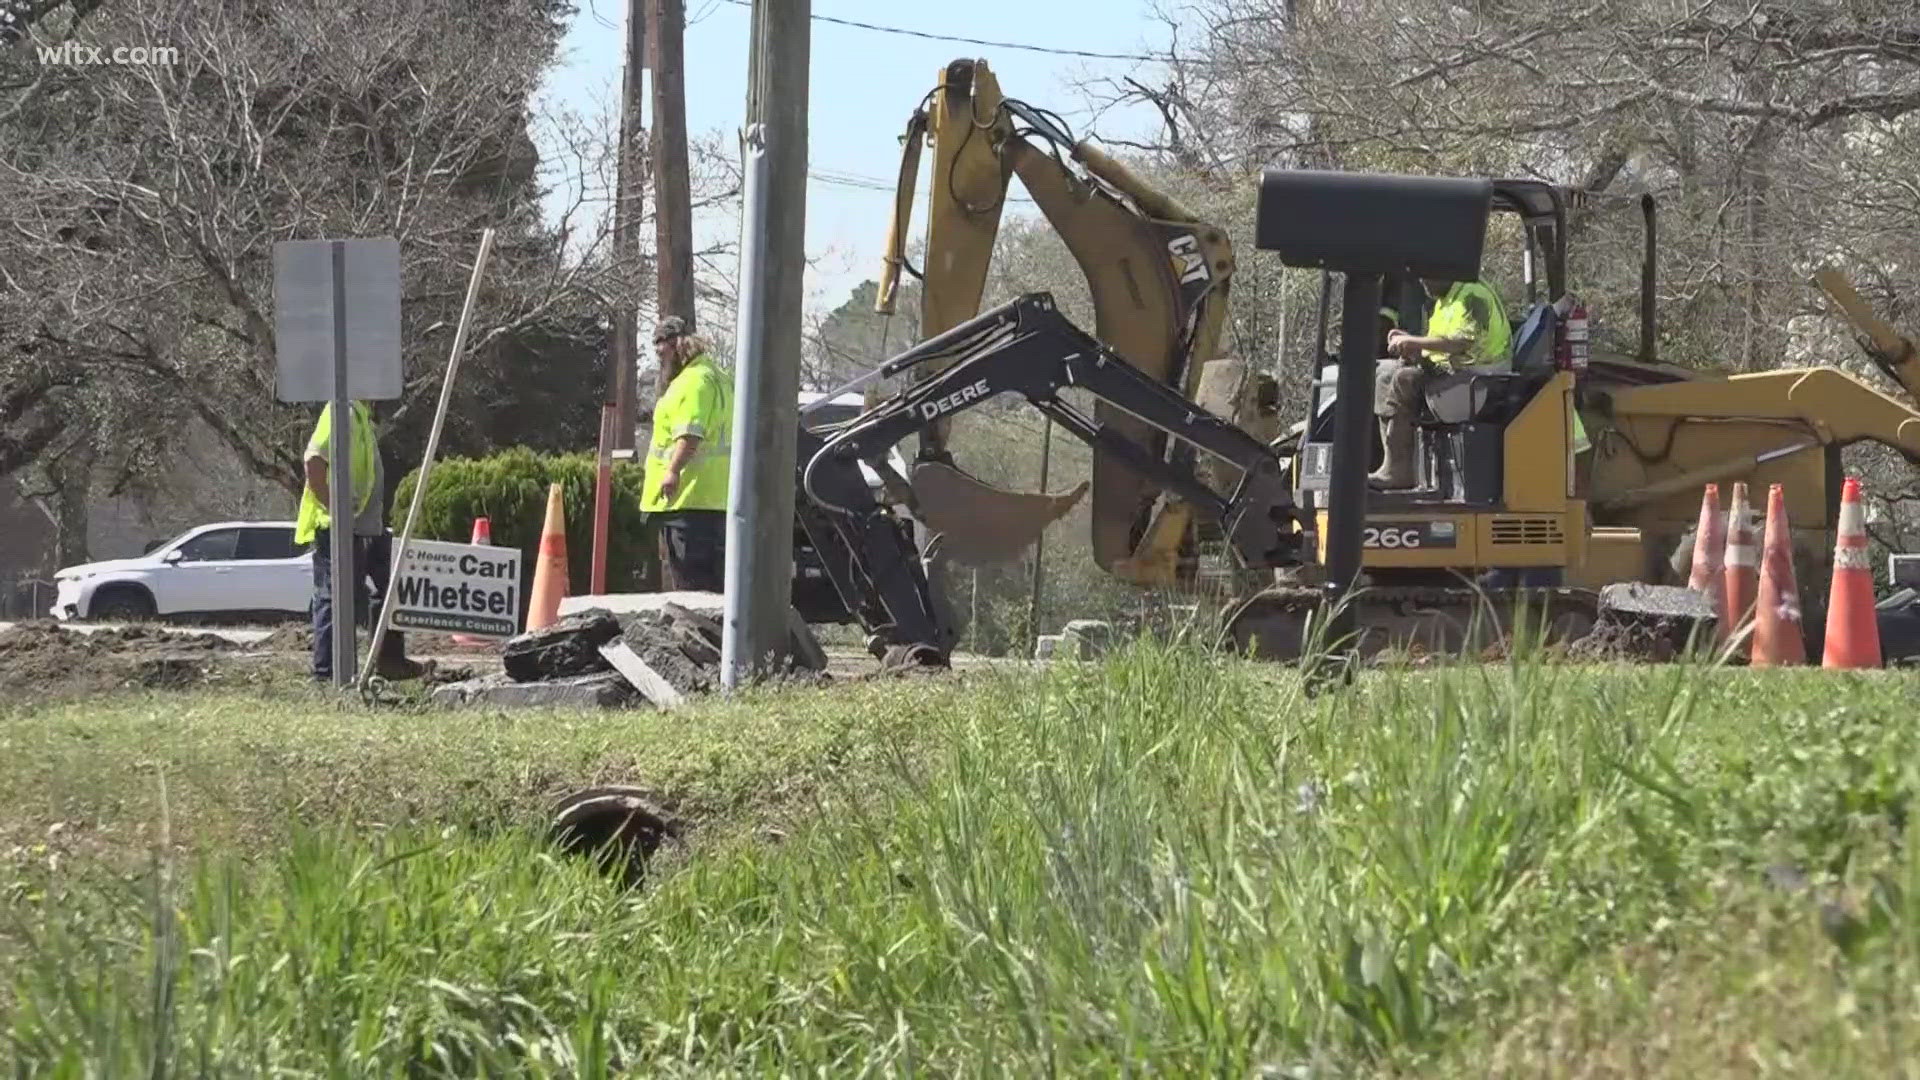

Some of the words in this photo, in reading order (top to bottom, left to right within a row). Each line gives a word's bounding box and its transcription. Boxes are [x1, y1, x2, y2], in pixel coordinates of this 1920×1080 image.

[1167, 234, 1210, 285] CAT
[920, 378, 991, 421] DEERE
[1363, 527, 1420, 548] 26G
[417, 550, 456, 562] House
[459, 554, 516, 580] Carl
[397, 576, 515, 616] Whetsel
[396, 613, 462, 628] Experience
